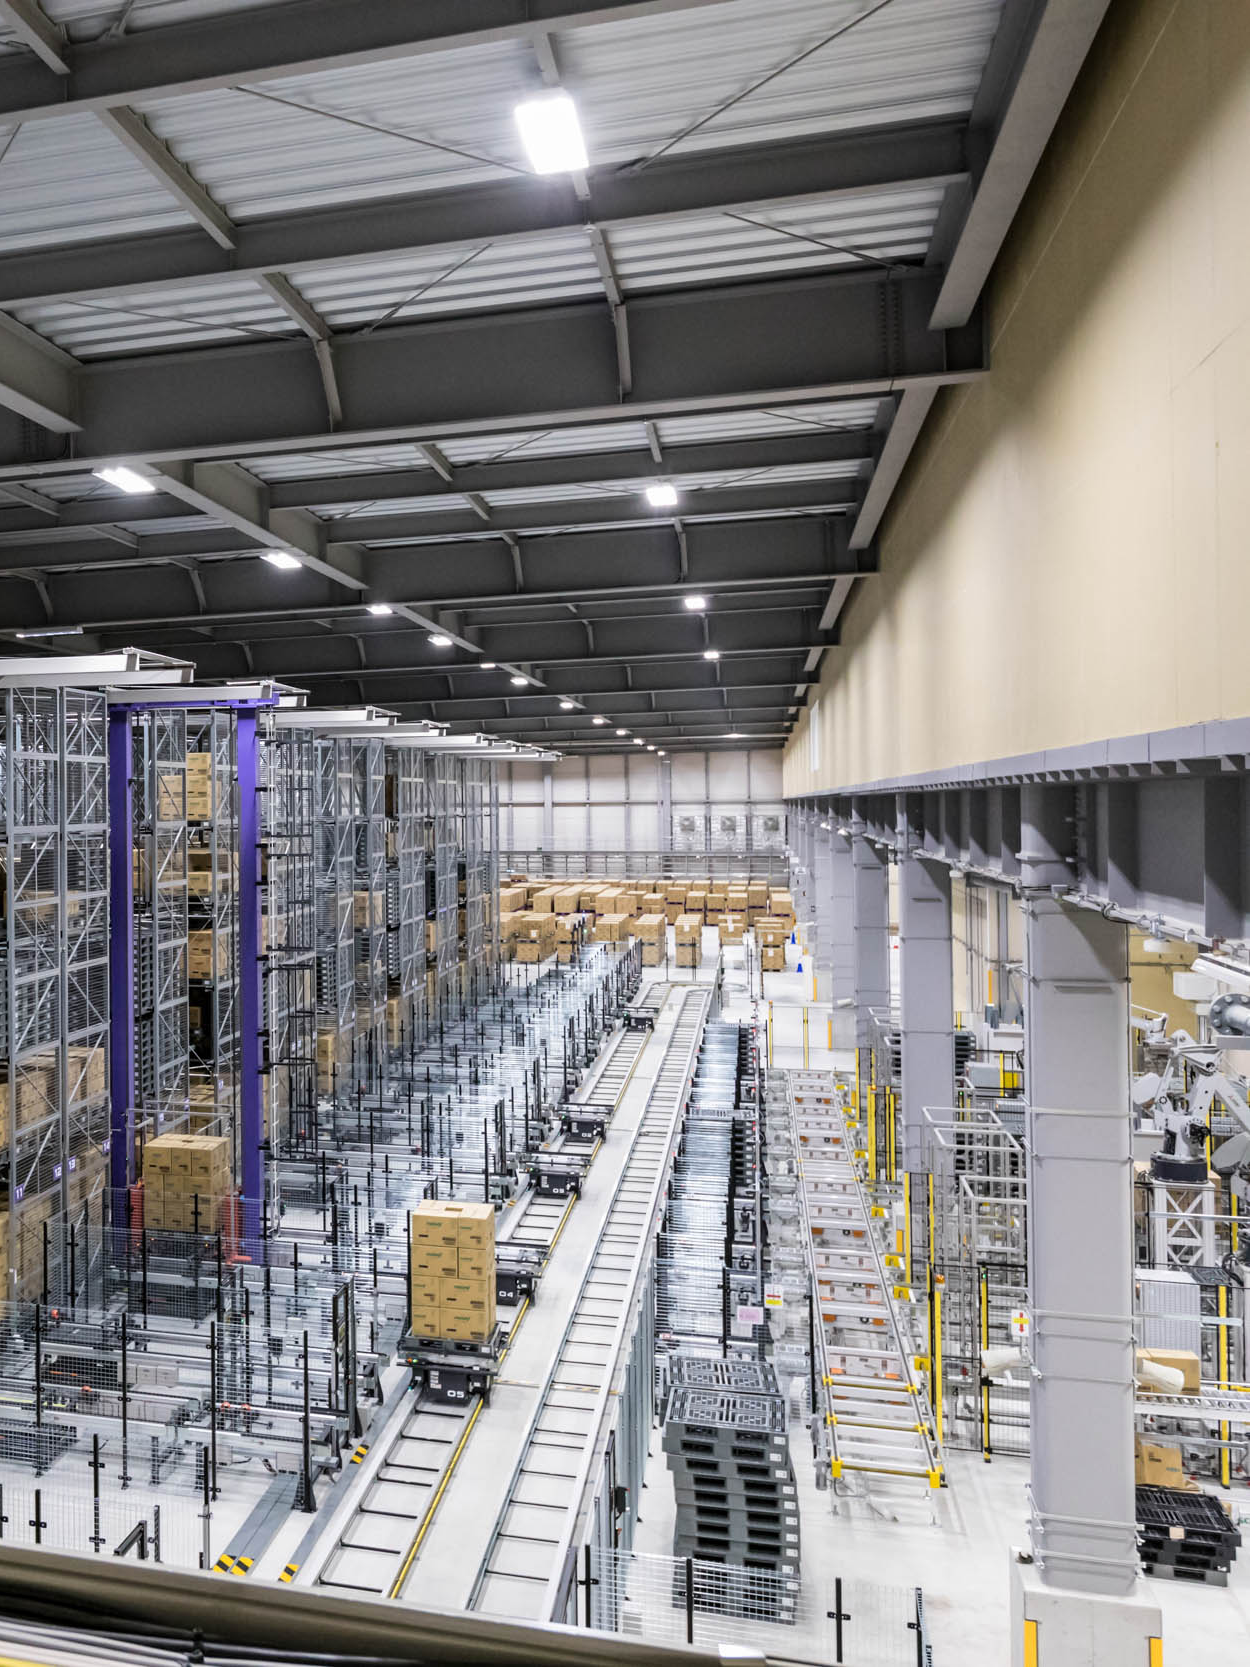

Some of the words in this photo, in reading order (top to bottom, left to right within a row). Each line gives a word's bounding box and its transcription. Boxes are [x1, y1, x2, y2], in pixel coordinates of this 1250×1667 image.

[68, 1158, 76, 1170] 13
[54, 1166, 62, 1178] 12
[16, 1187, 22, 1200] 11
[446, 1390, 465, 1398] 05
